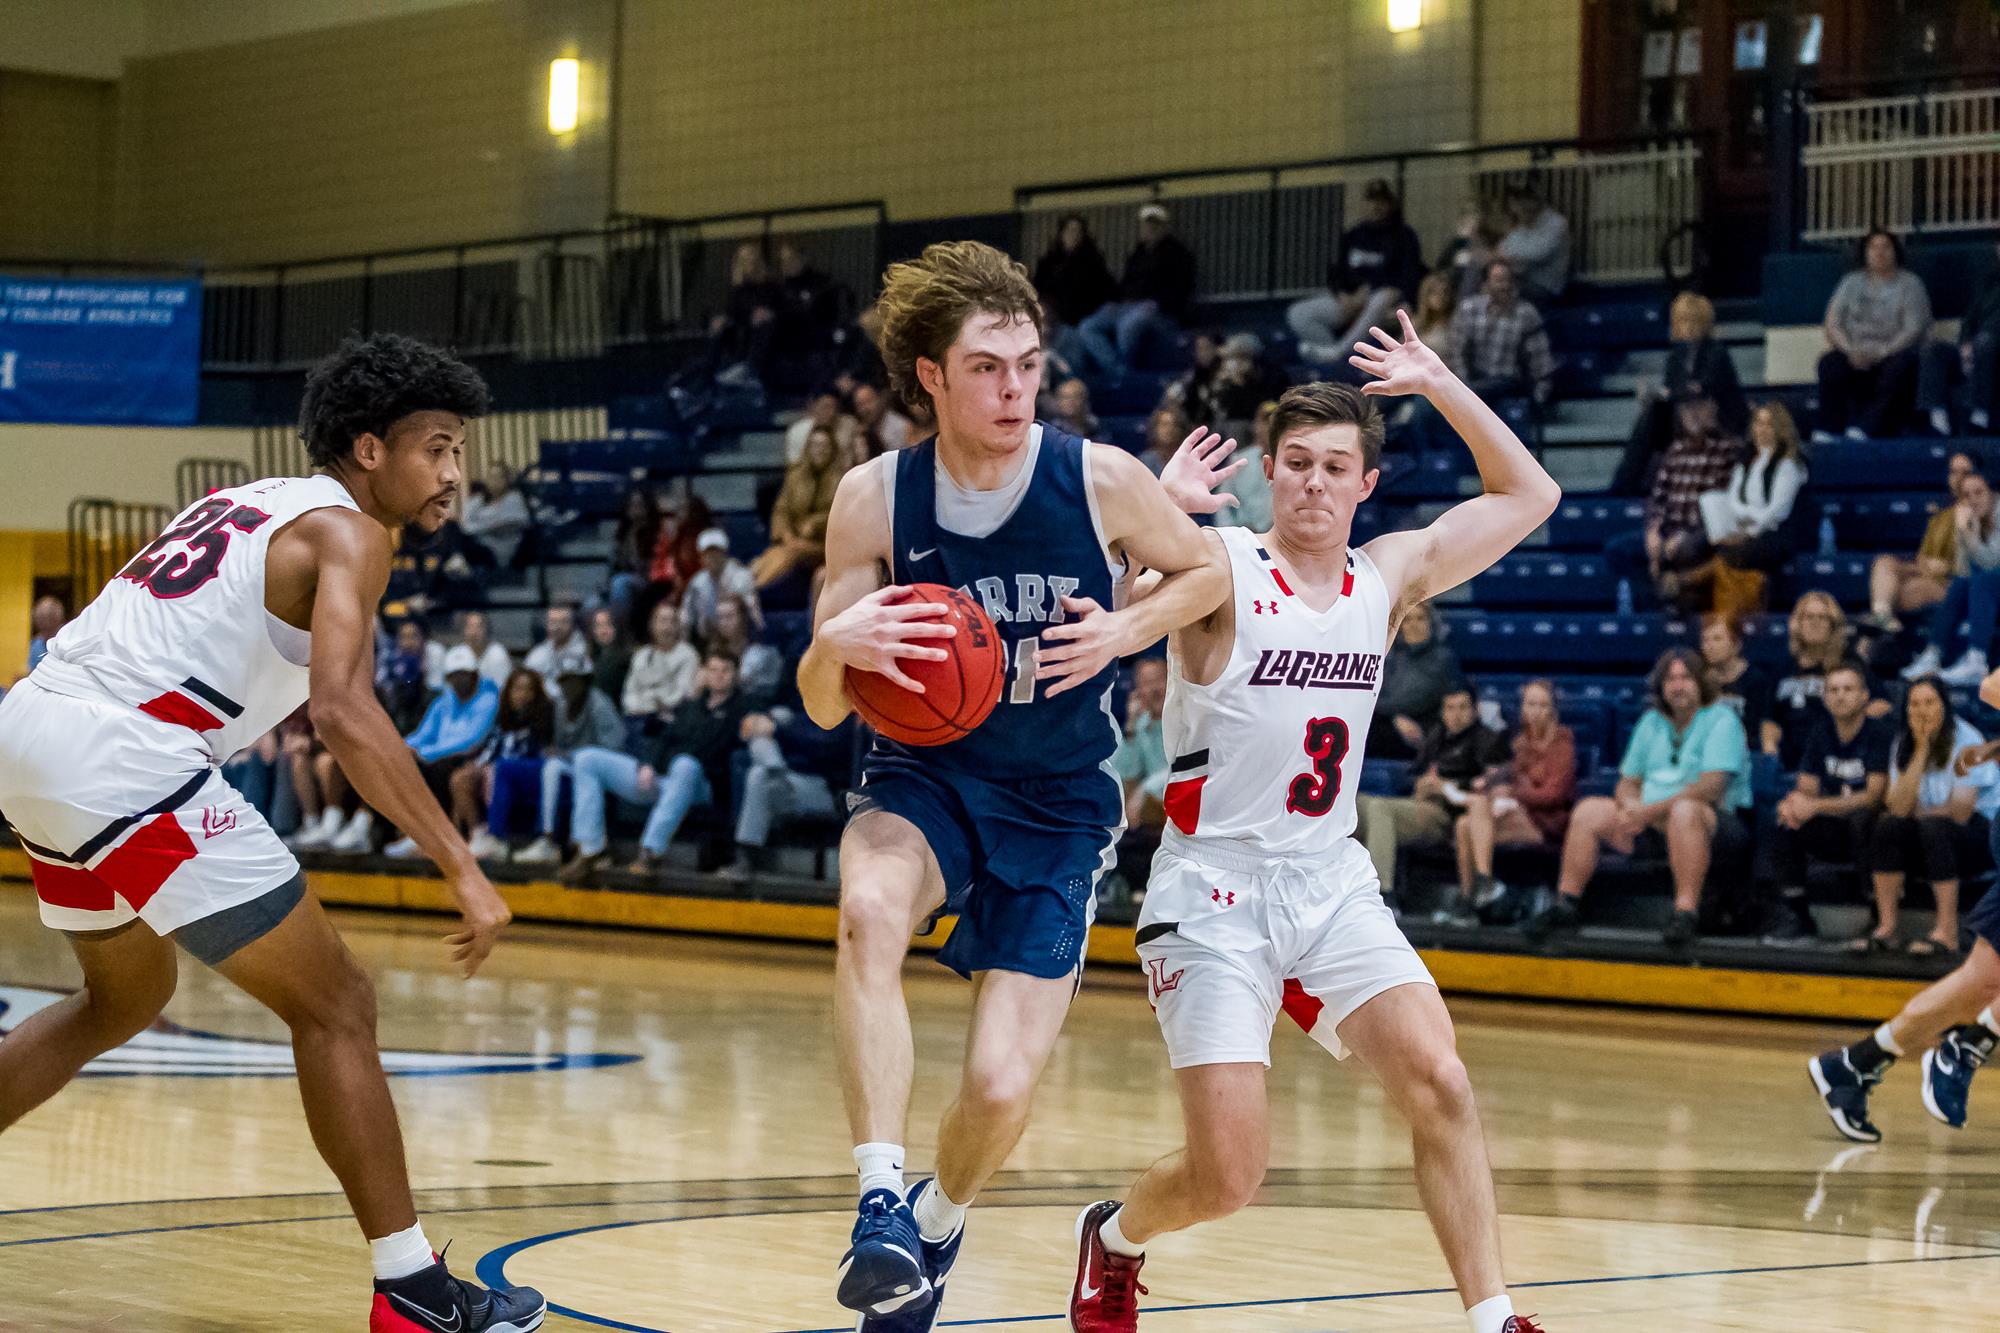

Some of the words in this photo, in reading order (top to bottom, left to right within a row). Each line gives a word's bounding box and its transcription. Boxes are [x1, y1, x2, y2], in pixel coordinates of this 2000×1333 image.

[154, 289, 188, 304] FOR
[112, 498, 272, 599] 25
[958, 573, 1080, 624] RRY
[997, 636, 1040, 704] 1
[1248, 649, 1382, 691] LAGRANGE
[1286, 716, 1350, 817] 3
[1148, 957, 1185, 998] L
